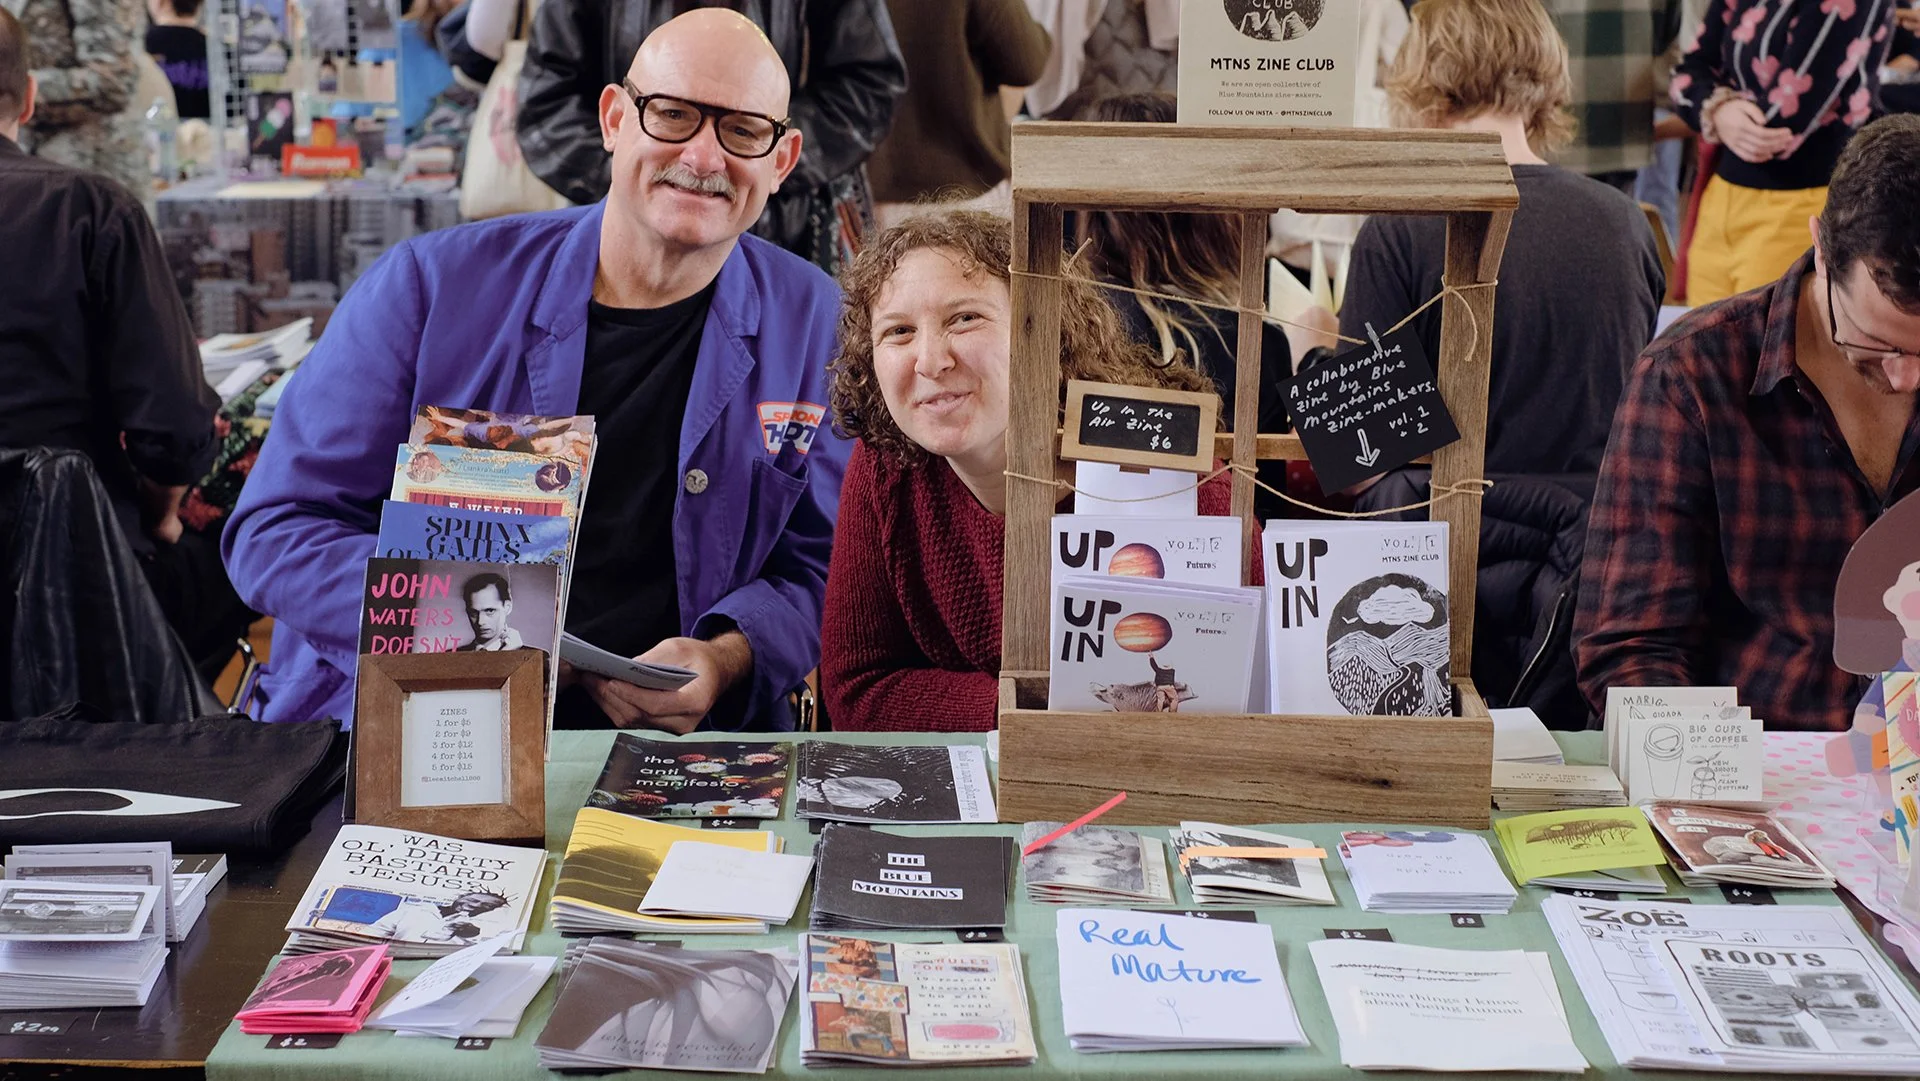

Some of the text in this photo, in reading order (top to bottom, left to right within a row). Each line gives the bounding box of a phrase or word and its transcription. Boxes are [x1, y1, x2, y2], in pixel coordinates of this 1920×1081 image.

[1210, 58, 1335, 71] MTNS ZINE CLUB
[1290, 344, 1402, 399] A collaborative
[1296, 360, 1406, 413] zine by Blue
[1091, 400, 1110, 414] Up
[1418, 405, 1430, 418] 1
[1089, 416, 1116, 427] Air
[1417, 422, 1429, 434] 2
[1150, 435, 1172, 450] $6
[425, 515, 532, 543] SPHINX
[426, 536, 520, 560] GATES
[1060, 529, 1115, 571] UP
[1186, 561, 1217, 570] Futures
[1276, 538, 1329, 581] UP
[371, 572, 453, 599] JOHN
[1063, 596, 1122, 632] UP
[1282, 585, 1319, 629] IN
[368, 608, 454, 626] WATERS
[1061, 631, 1104, 663] IN
[440, 708, 467, 716] ZINES
[1689, 725, 1742, 734] BIG CUPS
[457, 741, 473, 749] $12
[1708, 735, 1749, 743] COFFEE
[457, 751, 473, 760] $14
[644, 755, 675, 765] the
[636, 779, 739, 788] manifesto
[402, 834, 464, 853] WAS
[344, 852, 500, 882] BASTARD
[407, 848, 516, 870] DIRTY
[892, 856, 919, 864] THE
[349, 866, 483, 894] JESUS?
[884, 872, 925, 882] BLUE
[854, 882, 959, 899] MOUNTAINS
[1578, 905, 1688, 927] ZOË
[1079, 919, 1184, 951] Real
[1700, 948, 1826, 967] ROOTS
[1111, 953, 1262, 983] Mature
[1359, 989, 1405, 998] Some
[1410, 993, 1460, 1004] things
[1476, 997, 1519, 1005] know
[1364, 998, 1410, 1009] about
[1464, 1005, 1523, 1015] human
